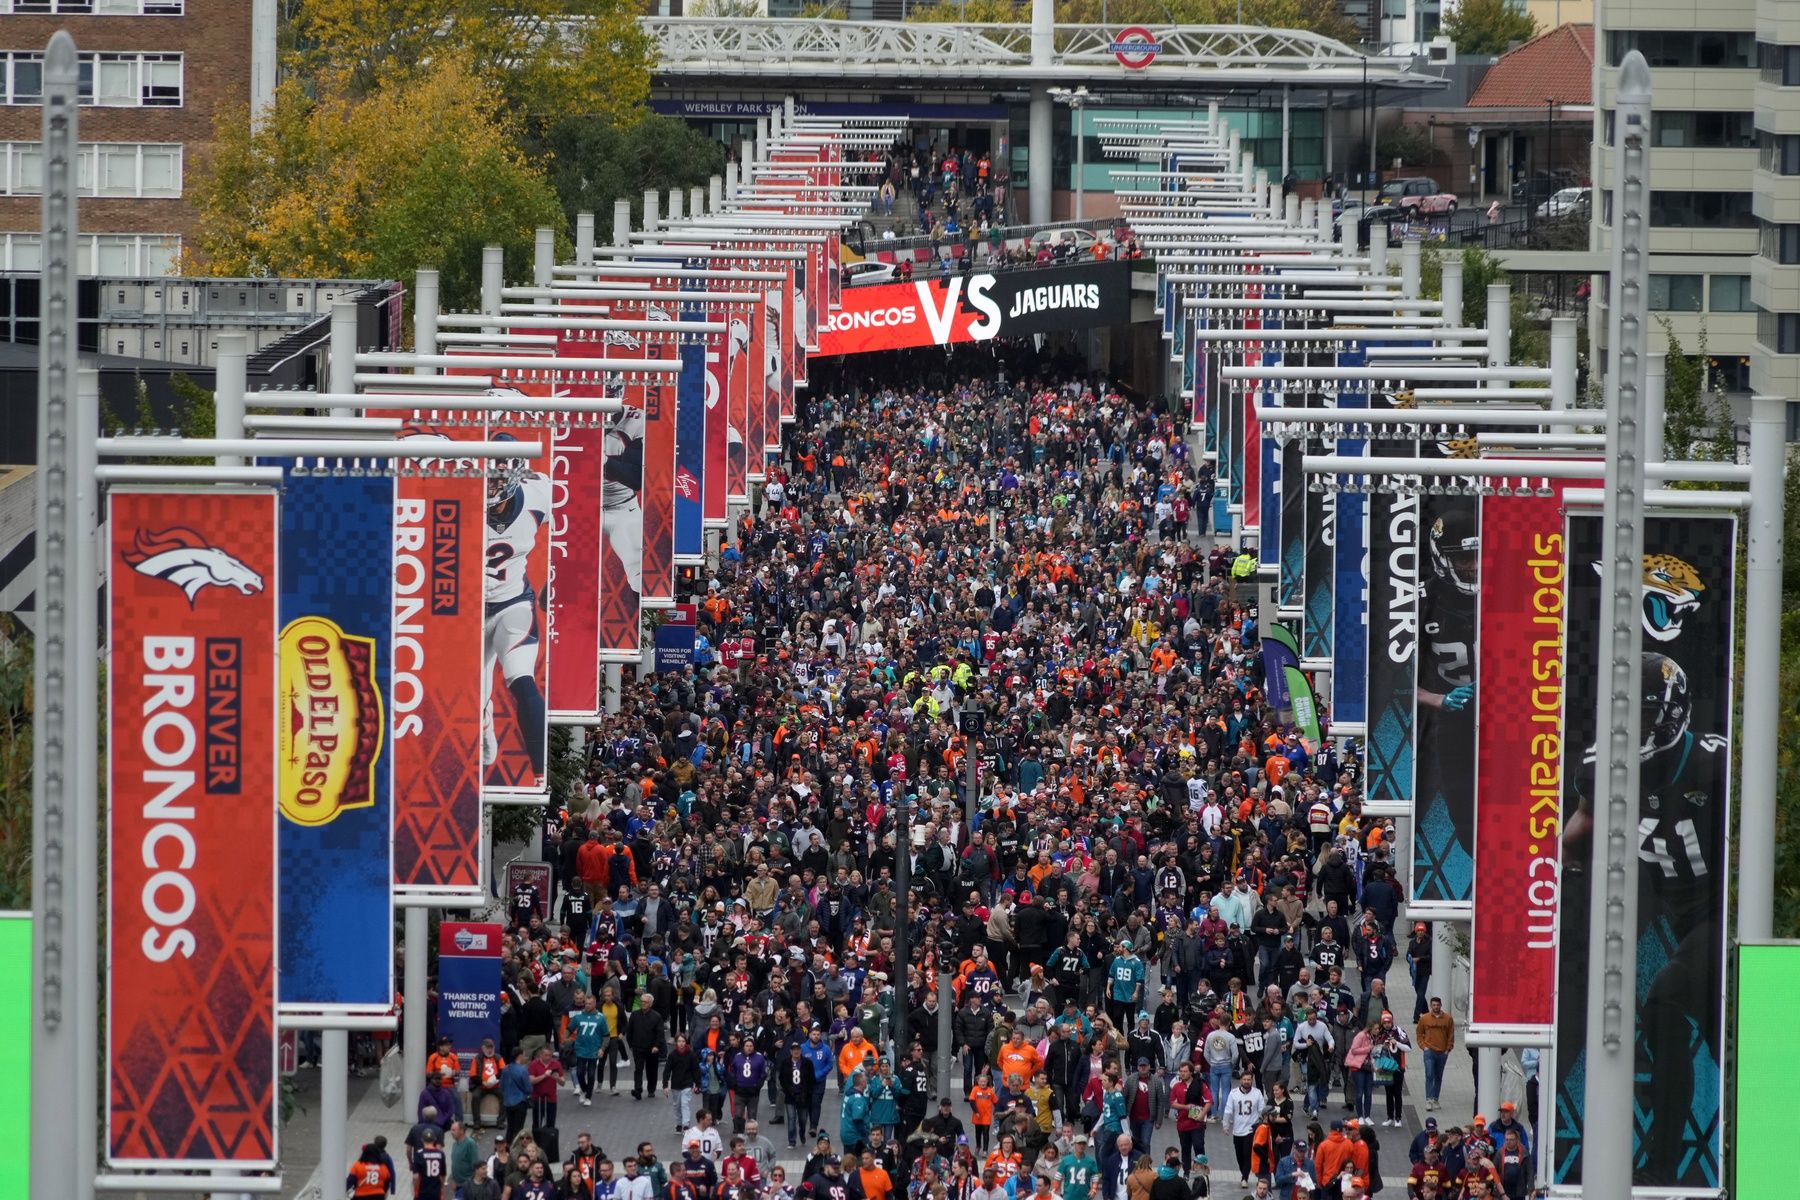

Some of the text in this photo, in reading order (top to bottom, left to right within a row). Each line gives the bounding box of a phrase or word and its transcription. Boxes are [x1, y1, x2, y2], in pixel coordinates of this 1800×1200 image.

[685, 104, 732, 113] WEMBLEY
[737, 104, 762, 114] PARK
[828, 274, 1100, 344] RONCOS VS JAGUARS
[647, 348, 658, 415] DVER
[676, 474, 696, 498] Virgin
[788, 488, 797, 496] 44
[814, 544, 822, 553] 72
[434, 504, 456, 610] DENVER
[1388, 473, 1418, 663] AGUARS
[393, 498, 426, 738] BRONCOS
[298, 636, 332, 692] OLD
[208, 642, 237, 787] DENVER
[310, 695, 338, 730] EL
[1318, 754, 1327, 765] 87
[142, 636, 196, 962] BRONCOS
[1164, 876, 1177, 889] 12
[518, 894, 531, 908] 25
[571, 902, 583, 914] 16
[1320, 952, 1336, 966] 93
[1369, 945, 1377, 959] 3
[1062, 956, 1079, 972] 27
[1116, 966, 1133, 982] 99
[974, 982, 989, 994] 60
[444, 992, 496, 1002] THANKS FOR
[452, 1002, 487, 1010] VISITING
[448, 1010, 490, 1018] WEMBLEY
[579, 1021, 597, 1036] 77
[1245, 1037, 1264, 1052] 60
[485, 1062, 494, 1076] 3
[743, 1062, 751, 1078] 8
[792, 1069, 801, 1085] 8
[1237, 1100, 1253, 1118] 13
[426, 1160, 440, 1177] 18
[366, 1171, 379, 1185] 18
[1069, 1168, 1088, 1185] 14
